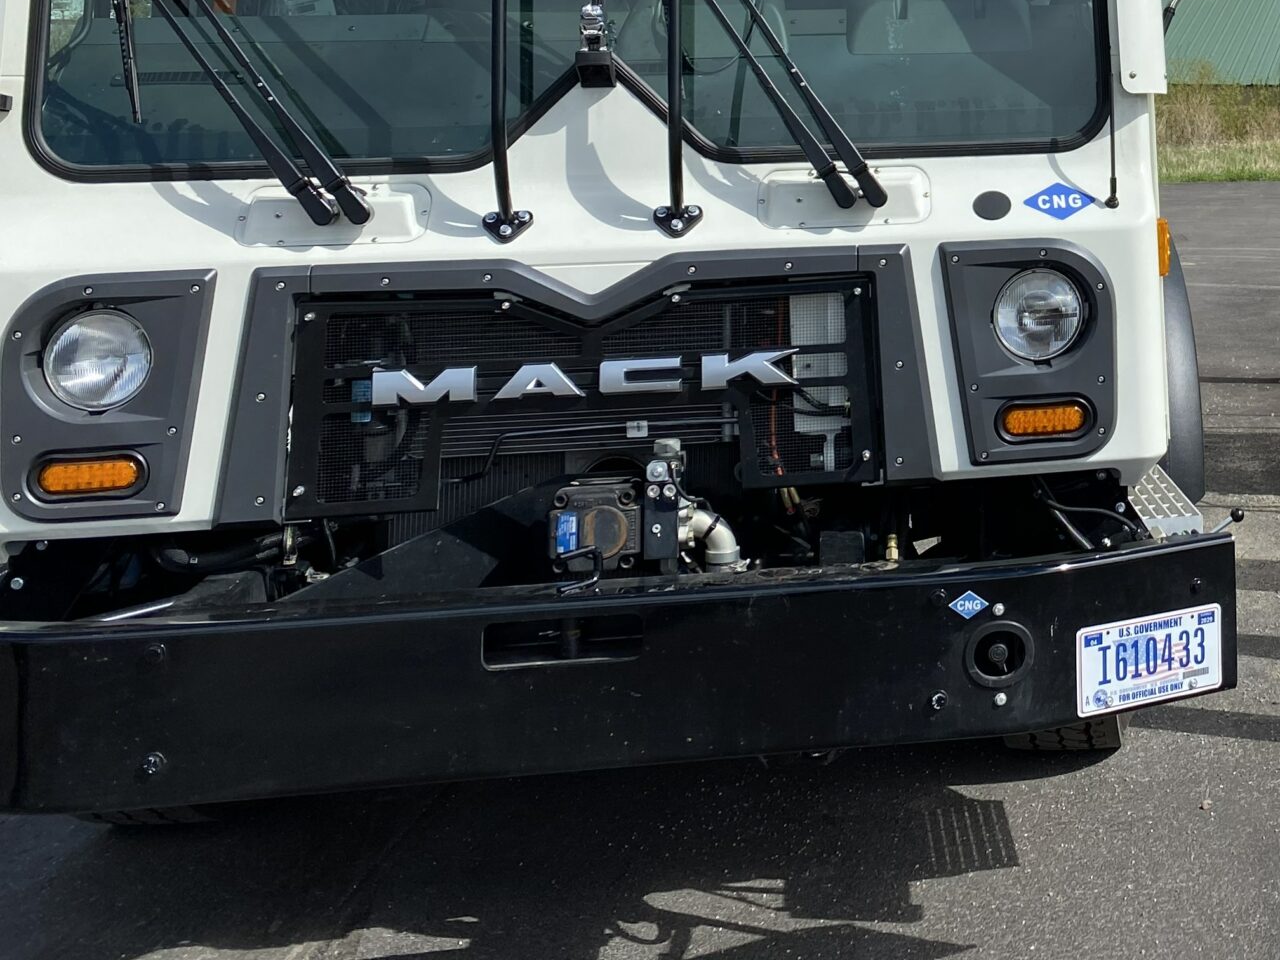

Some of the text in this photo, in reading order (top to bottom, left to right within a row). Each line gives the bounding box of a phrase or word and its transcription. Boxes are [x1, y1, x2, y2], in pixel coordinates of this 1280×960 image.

[1037, 194, 1082, 209] CNG
[372, 348, 799, 405] MACK
[957, 600, 981, 611] CNG
[1118, 617, 1183, 638] U.S. GOVERNMENT
[1098, 627, 1206, 686] I610433
[1119, 693, 1130, 703] FOR
[1131, 688, 1157, 700] OFFICIAL
[1157, 684, 1169, 694] USE
[1169, 681, 1184, 691] ONLY
